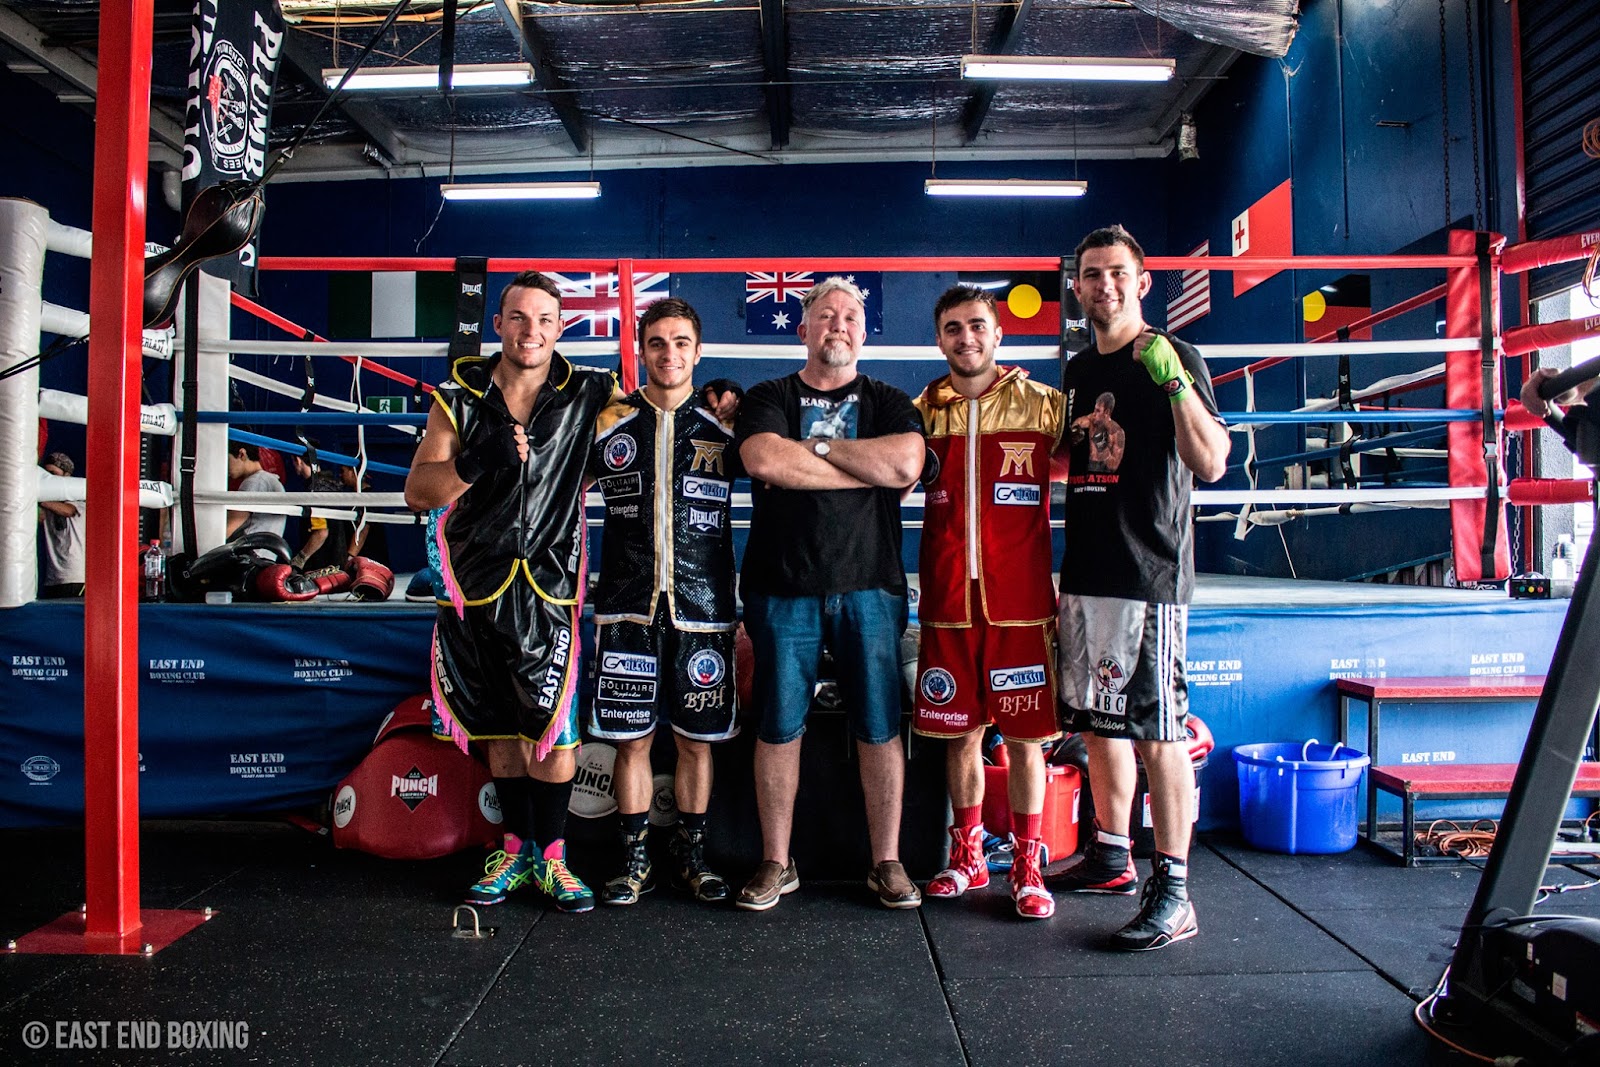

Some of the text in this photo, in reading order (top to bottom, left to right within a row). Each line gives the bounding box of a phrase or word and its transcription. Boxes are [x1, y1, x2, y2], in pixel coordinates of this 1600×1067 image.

[1580, 232, 1600, 249] EVER
[142, 337, 166, 354] ERLAST
[800, 396, 832, 409] EAST
[140, 413, 166, 429] ERLAST
[1086, 474, 1120, 484] ATSON
[689, 506, 720, 529] EVERLAST
[12, 655, 66, 666] EAST END
[149, 659, 205, 669] EAST END
[294, 658, 323, 668] EAST
[1330, 658, 1361, 669] EAST
[1470, 652, 1525, 665] EAST END
[538, 628, 571, 709] EAST END
[1186, 660, 1242, 671] EAST END
[1469, 665, 1526, 676] BOXING CLUB
[12, 668, 69, 677] BOXING CLUB
[149, 671, 206, 680] BOXING CLUB
[293, 669, 354, 678] BOXING CLUB
[1219, 672, 1243, 681] CLUB
[1329, 671, 1363, 681] BOXING
[601, 680, 655, 693] SOLITAIRE
[684, 686, 725, 713] BFH
[999, 690, 1043, 717] BFH
[600, 708, 651, 722] Enterprise
[920, 708, 968, 722] Enterprise
[230, 753, 285, 764] EAST END
[1402, 751, 1456, 763] EAST END
[230, 766, 287, 774] BOXING CLUB
[391, 773, 438, 798] PUNCH
[573, 786, 605, 799] QUIPMENT
